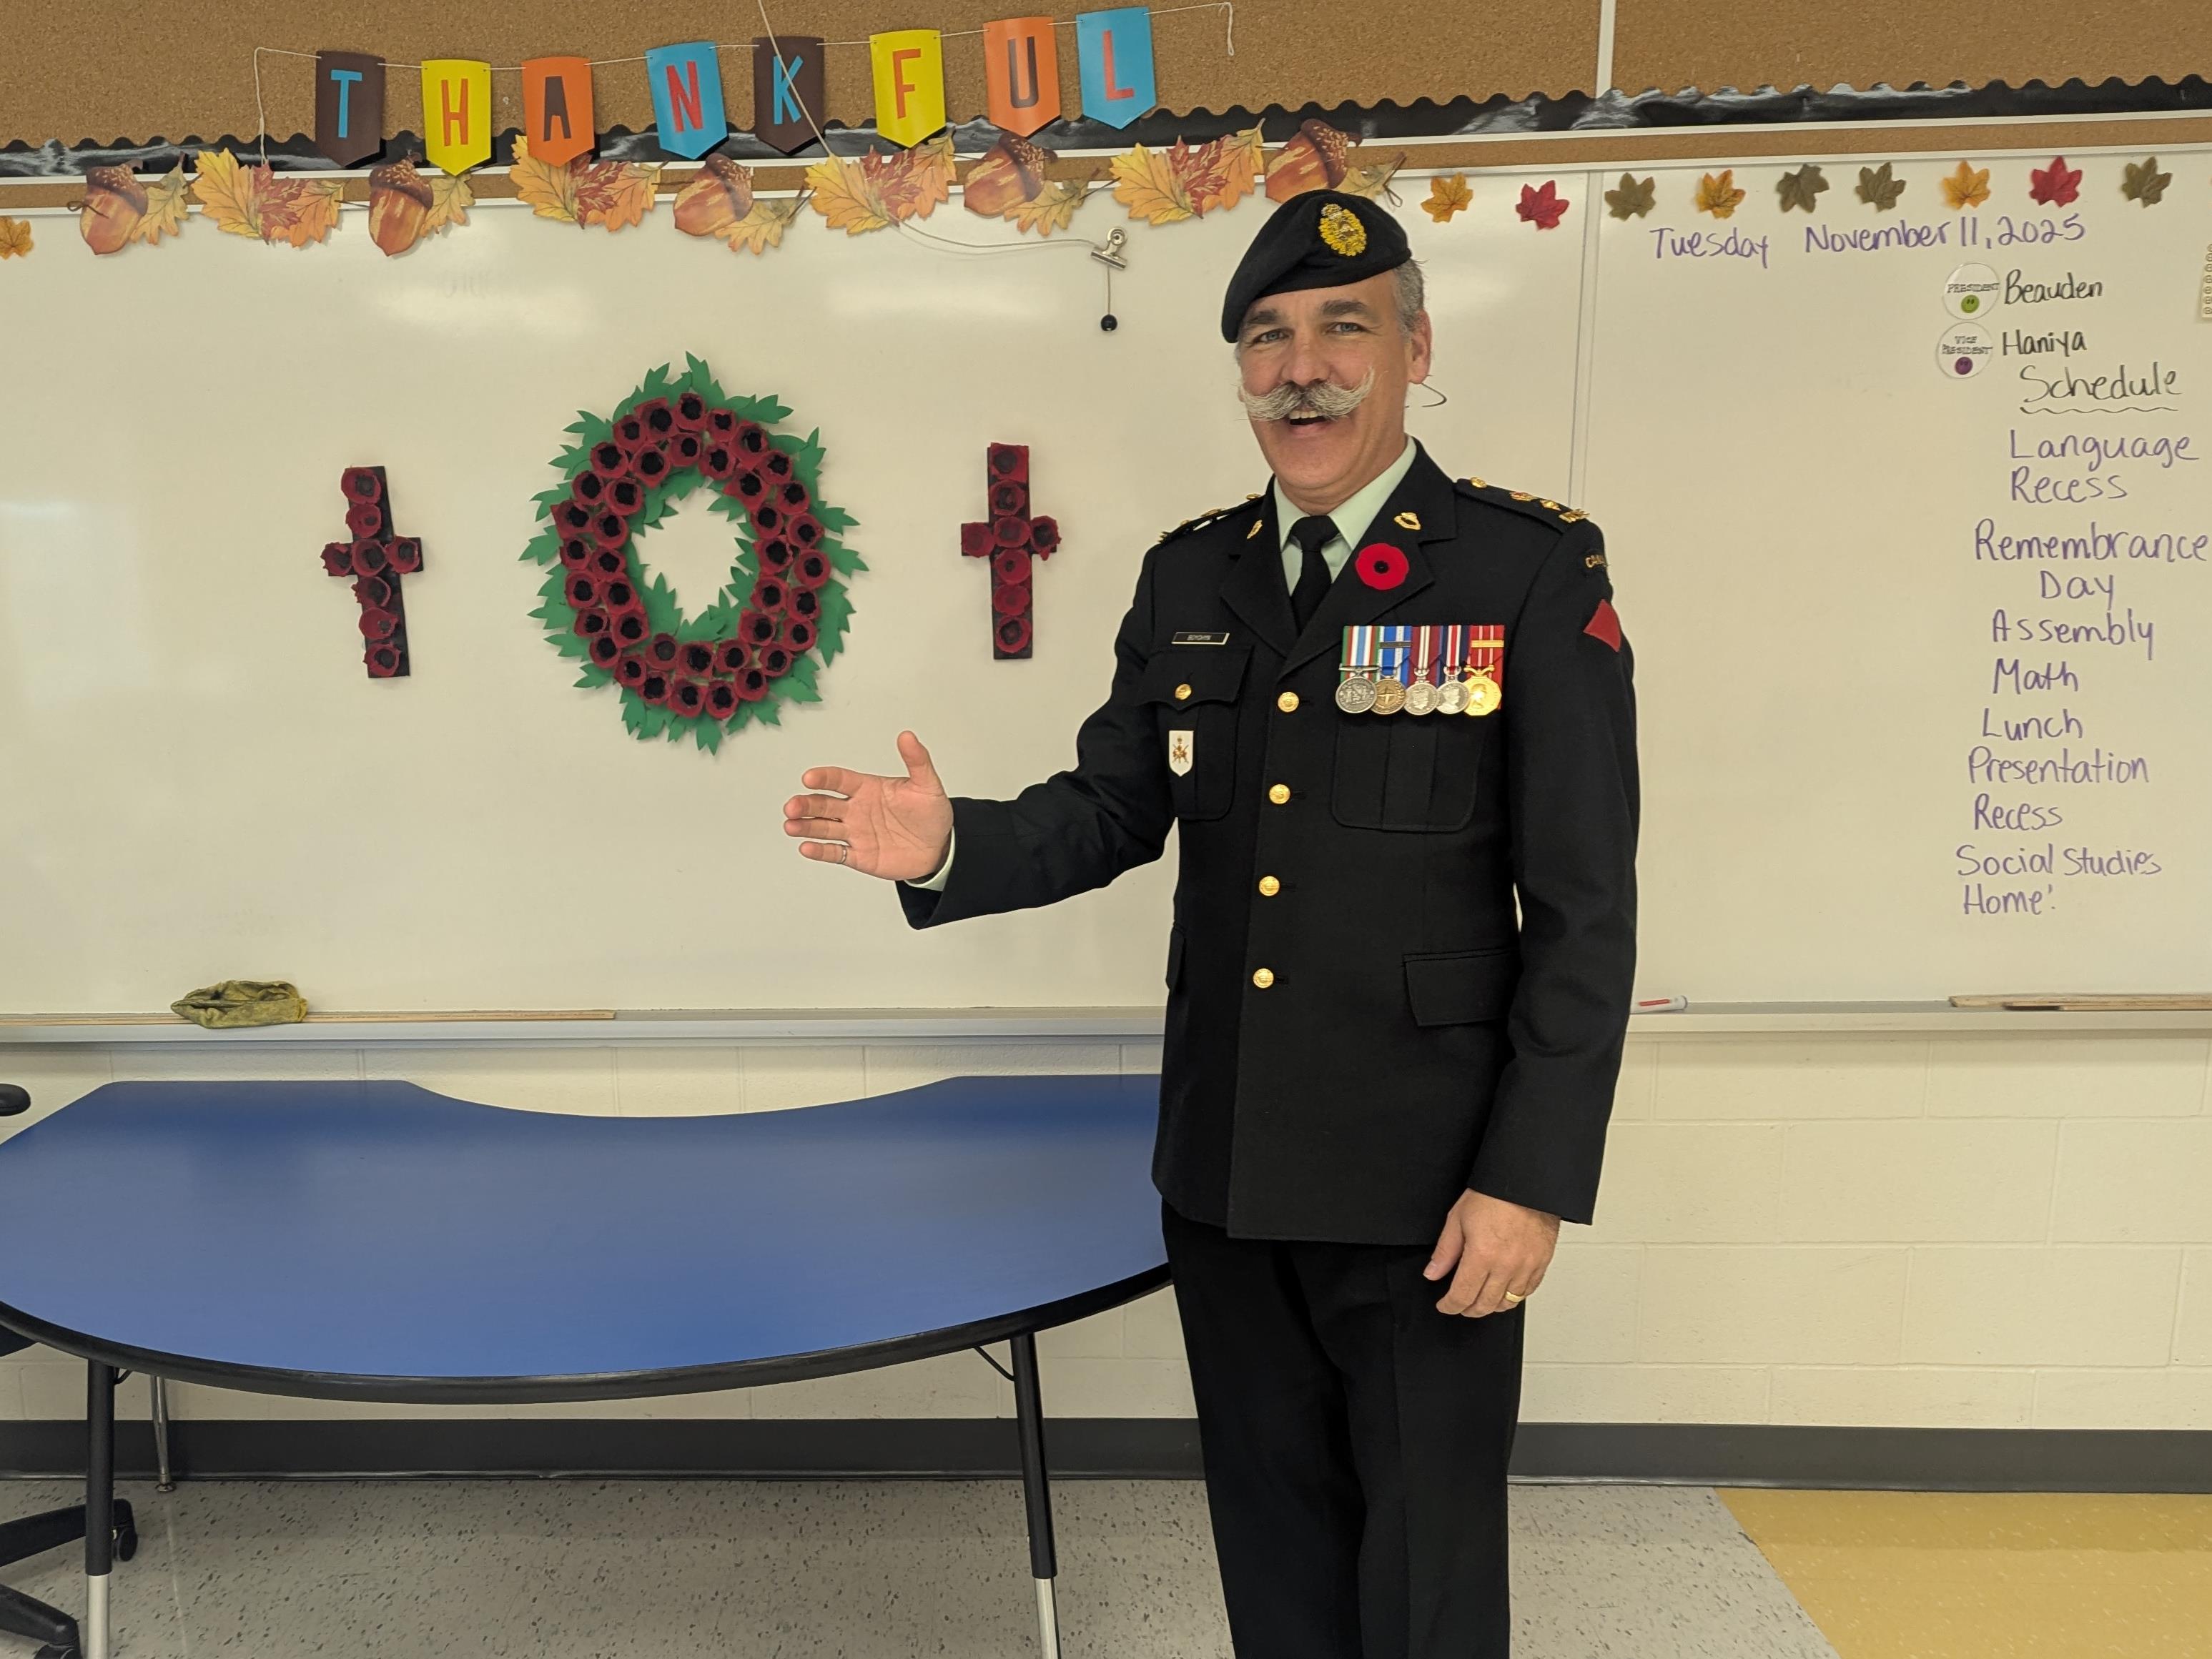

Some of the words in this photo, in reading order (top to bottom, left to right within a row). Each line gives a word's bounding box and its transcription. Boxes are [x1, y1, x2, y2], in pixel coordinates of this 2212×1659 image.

[330, 30, 1135, 147] THANKFUL
[1649, 227, 1769, 269] Tuesday
[1805, 219, 1951, 253] November
[2003, 269, 2103, 305] Beauden
[2002, 329, 2088, 357] Haniya
[2019, 361, 2183, 403] Schedule
[2010, 429, 2200, 472] Language
[2011, 465, 2128, 504] Recess
[1974, 517, 2208, 563] Remembrance
[2040, 570, 2114, 610] Day
[1992, 608, 2154, 661] Assembly
[1993, 658, 2079, 695] Math
[1982, 708, 2083, 741] Lunch
[1967, 746, 2149, 785] Presentation
[1974, 793, 2063, 831] Recess
[1955, 843, 2053, 876] Social
[2063, 846, 2163, 877] Studies
